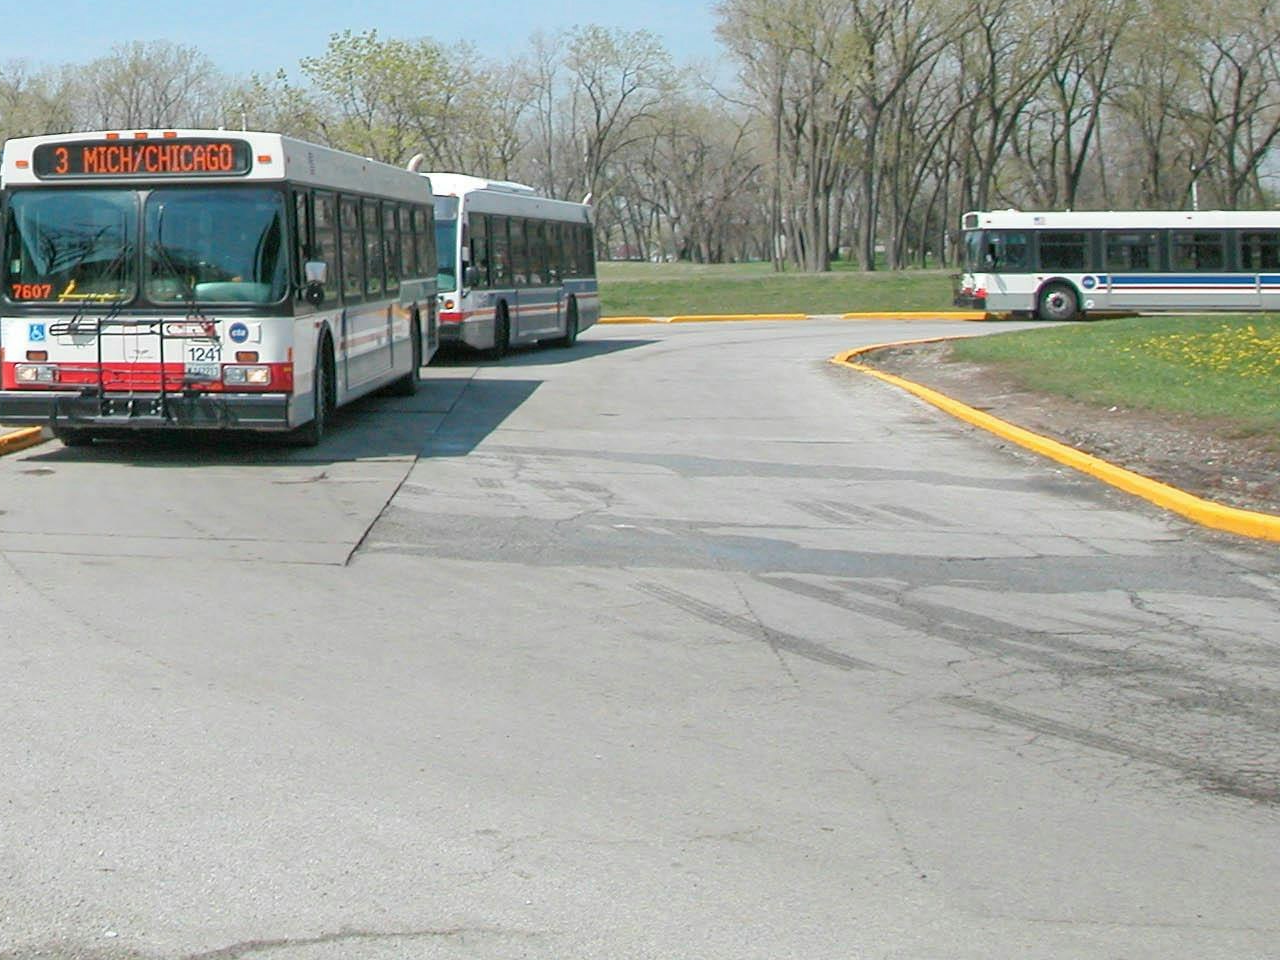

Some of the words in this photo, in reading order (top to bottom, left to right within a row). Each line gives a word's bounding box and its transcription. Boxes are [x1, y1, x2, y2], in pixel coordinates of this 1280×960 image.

[55, 146, 69, 174] 3
[83, 143, 233, 173] MICH/CHICAGO
[11, 283, 53, 300] 7607
[188, 347, 221, 361] 1241
